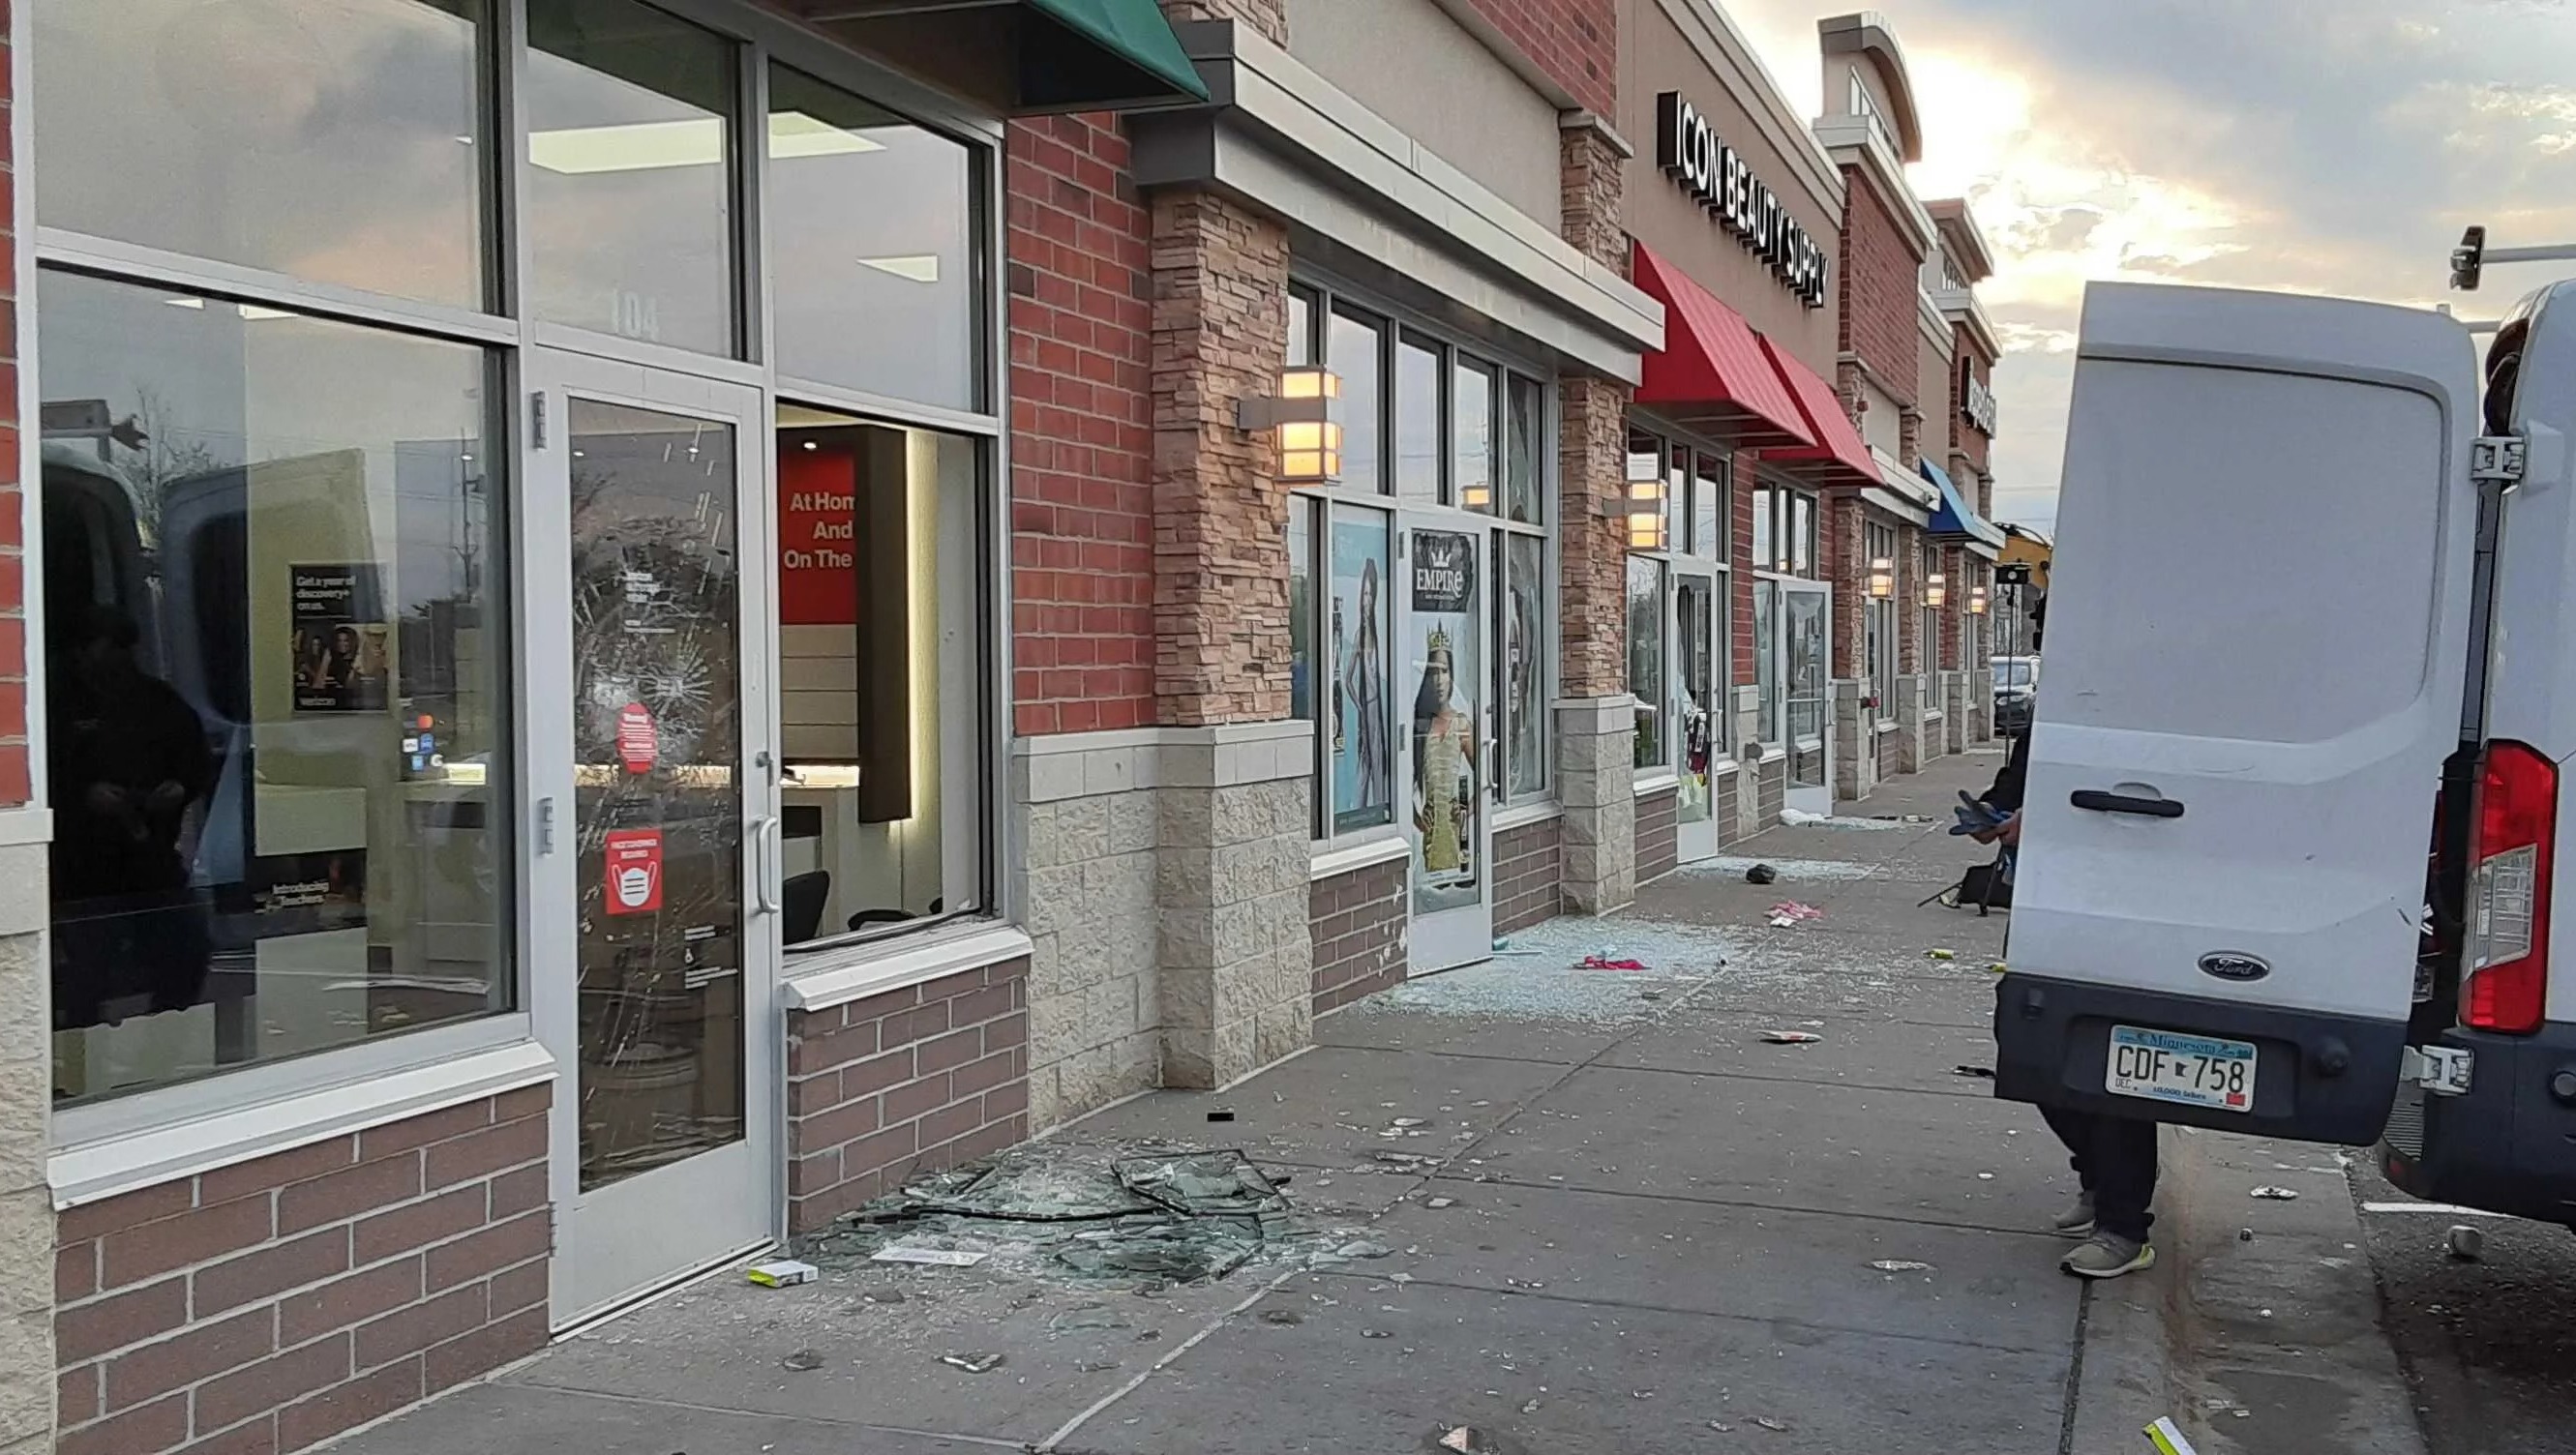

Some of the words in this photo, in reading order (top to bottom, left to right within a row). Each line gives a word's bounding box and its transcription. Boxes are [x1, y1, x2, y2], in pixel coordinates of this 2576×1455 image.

[1676, 91, 1722, 205] ICON
[1726, 147, 1784, 264] BEAUTY
[1787, 216, 1829, 305] SUPPLY
[611, 289, 660, 341] 104
[790, 492, 812, 512] At
[814, 491, 855, 511] Hom
[813, 520, 854, 540] And
[784, 549, 812, 569] On
[815, 549, 853, 568] The
[2213, 958, 2253, 975] Ford
[2149, 1033, 2215, 1054] Minnesota
[2116, 1046, 2170, 1082] CDF
[2194, 1055, 2245, 1093] 758
